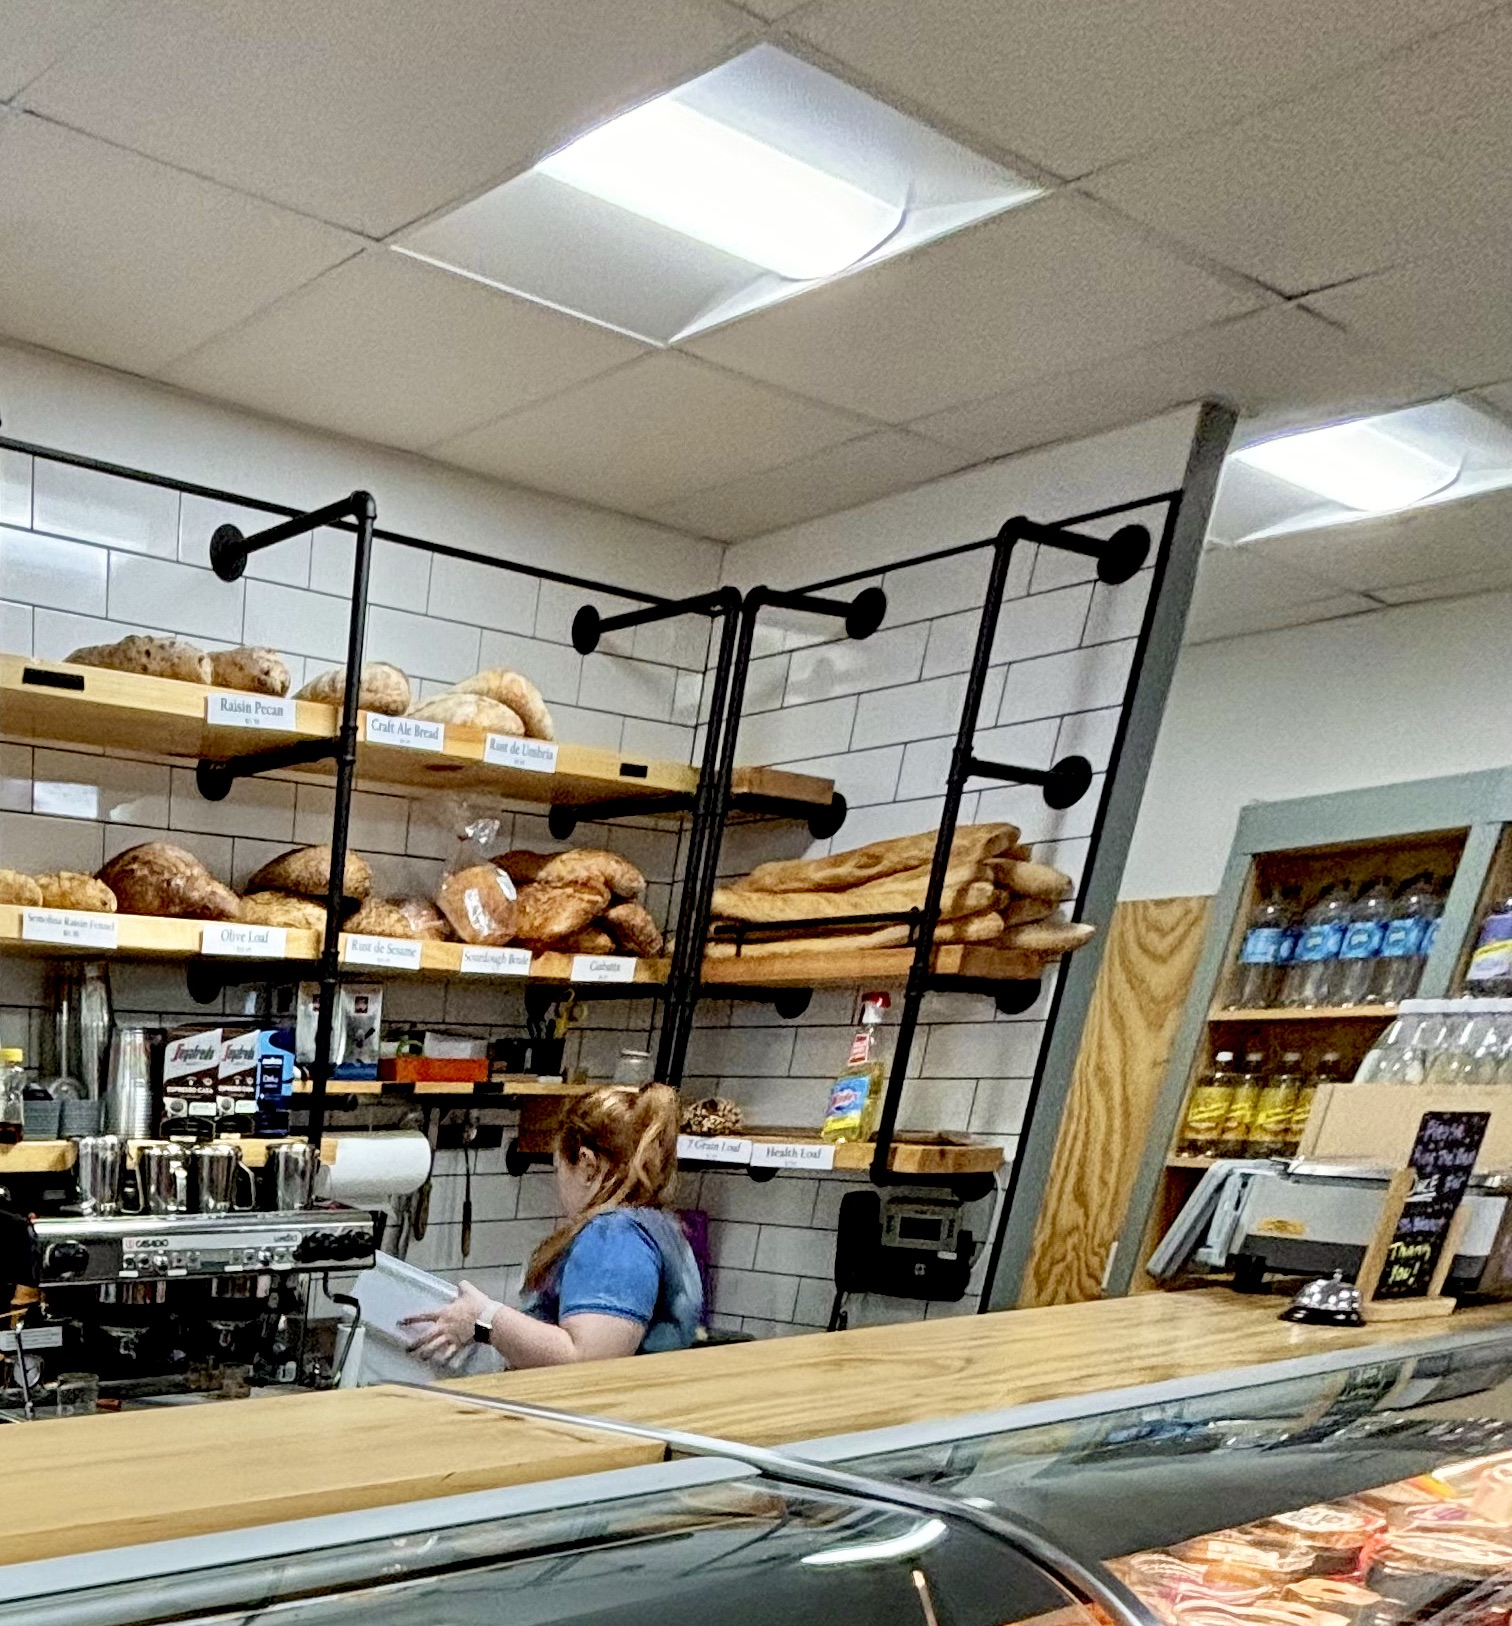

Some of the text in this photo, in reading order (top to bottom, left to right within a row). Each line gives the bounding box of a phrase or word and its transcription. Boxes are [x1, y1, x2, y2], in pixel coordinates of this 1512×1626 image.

[220, 698, 284, 717] Raisin Pecan
[370, 717, 440, 741] Craft Ale Bread
[220, 928, 269, 944] Olive Loaf
[721, 1141, 742, 1154] Loaf
[765, 1146, 822, 1160] Health Loaf
